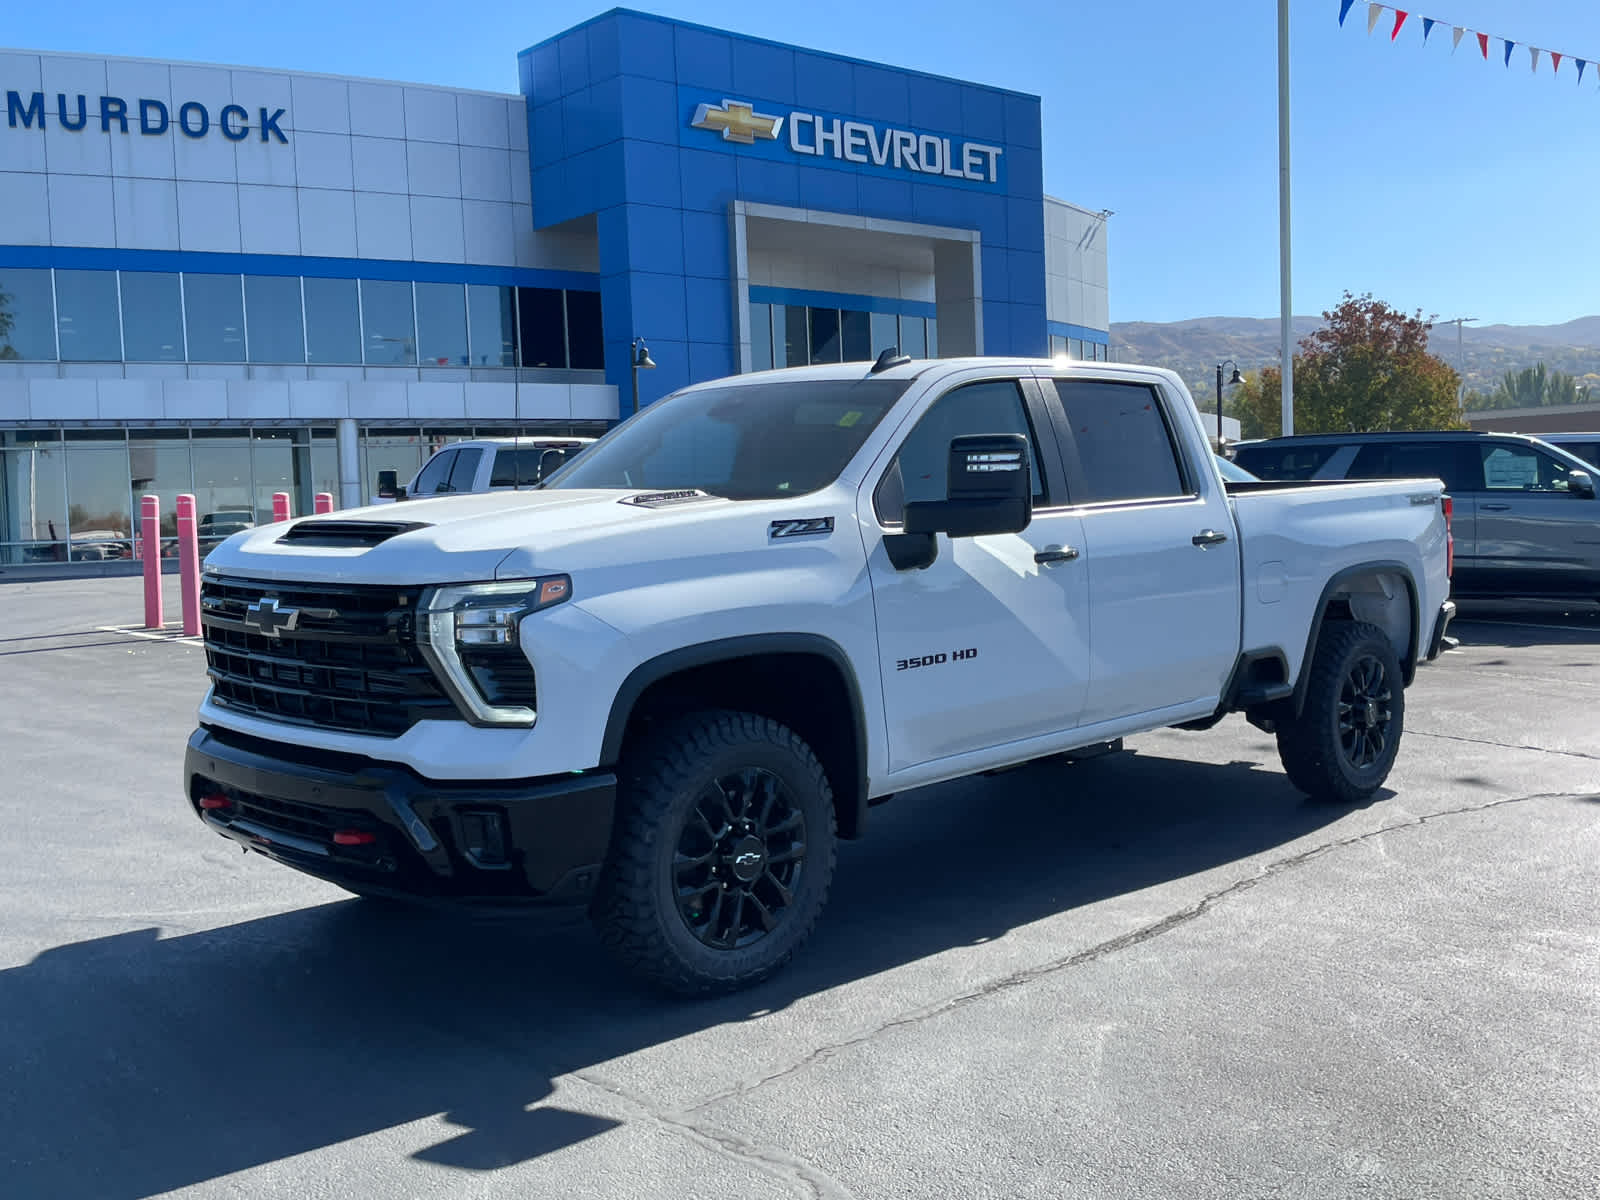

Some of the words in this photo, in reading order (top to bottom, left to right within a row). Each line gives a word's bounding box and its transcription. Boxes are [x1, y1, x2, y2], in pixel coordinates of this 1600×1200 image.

[6, 90, 289, 145] MURDOCK
[789, 111, 1002, 183] CHEVROLET
[896, 653, 947, 671] 3500
[952, 647, 978, 661] HD
